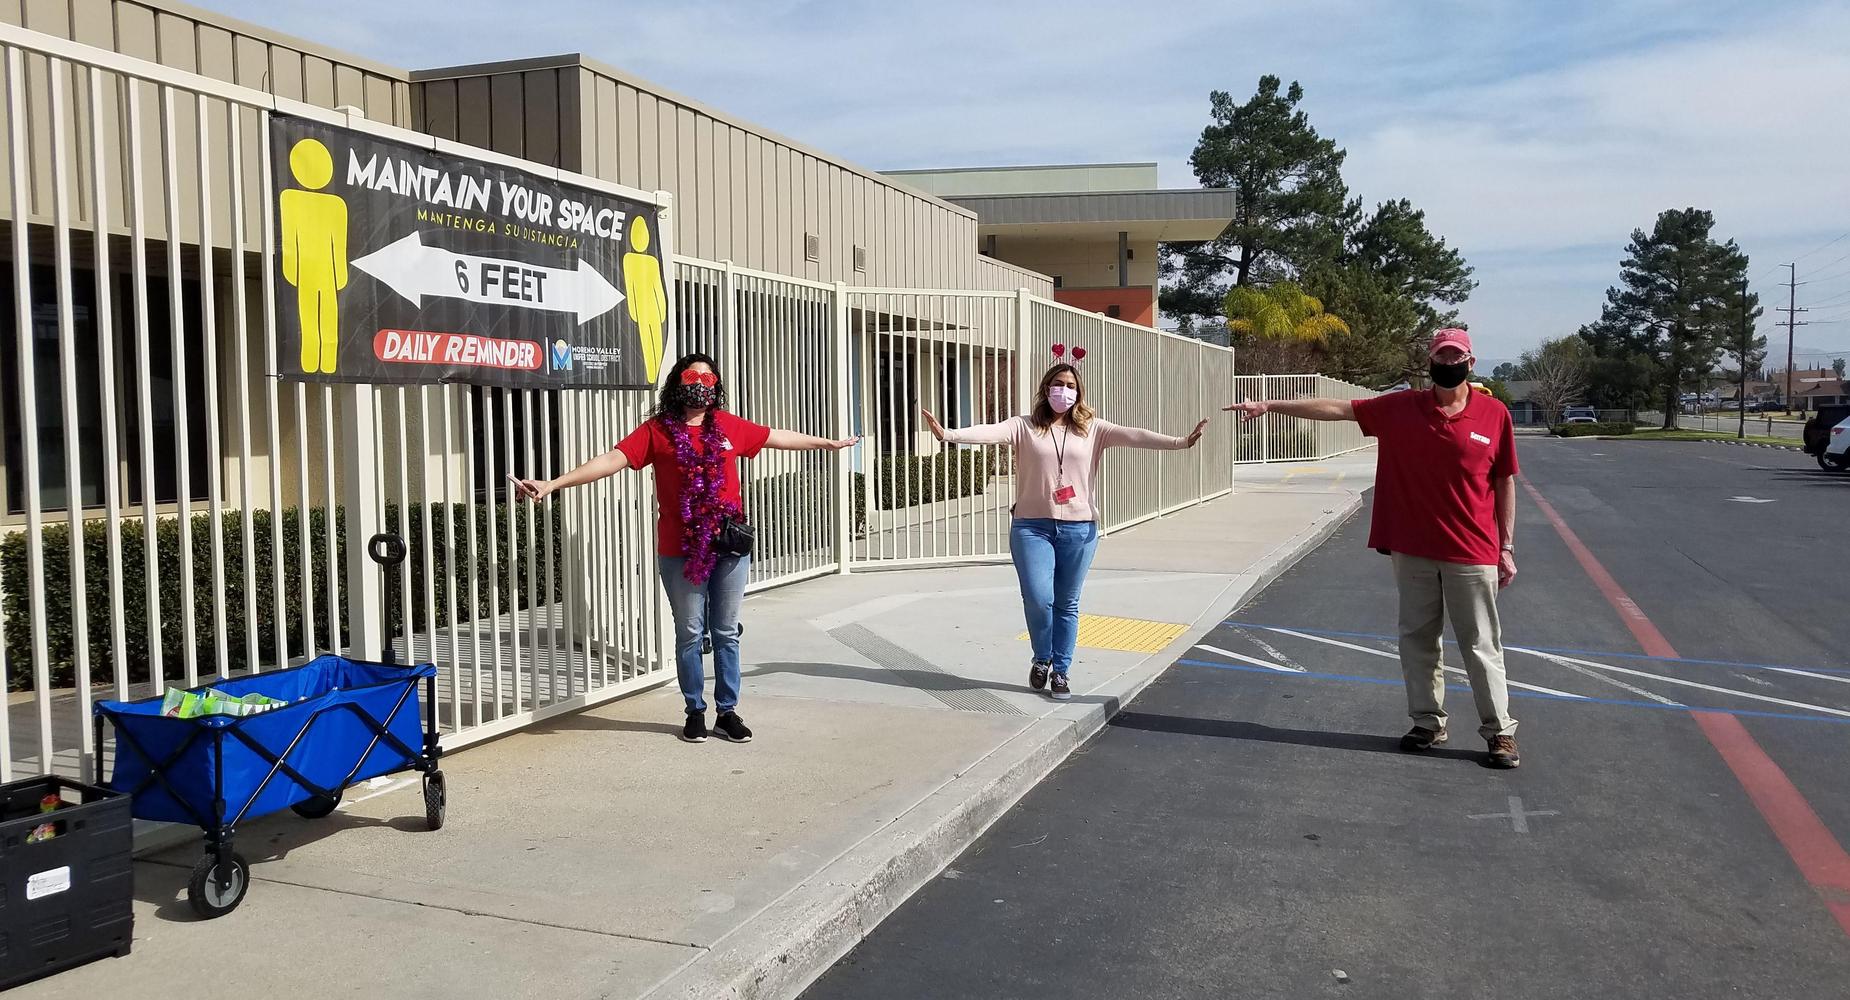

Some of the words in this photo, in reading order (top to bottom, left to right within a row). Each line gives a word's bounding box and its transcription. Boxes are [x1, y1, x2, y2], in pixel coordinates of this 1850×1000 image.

[346, 147, 492, 213] MAINTAIN
[499, 181, 552, 227] YOUR
[557, 199, 626, 241] SPACE
[417, 208, 496, 234] MANTENGA
[454, 259, 470, 294] 6
[480, 262, 547, 303] FEET
[383, 331, 441, 361] DAILY
[444, 335, 535, 367] REMINDER
[571, 346, 595, 354] MORENO
[596, 347, 621, 355] VALLEY
